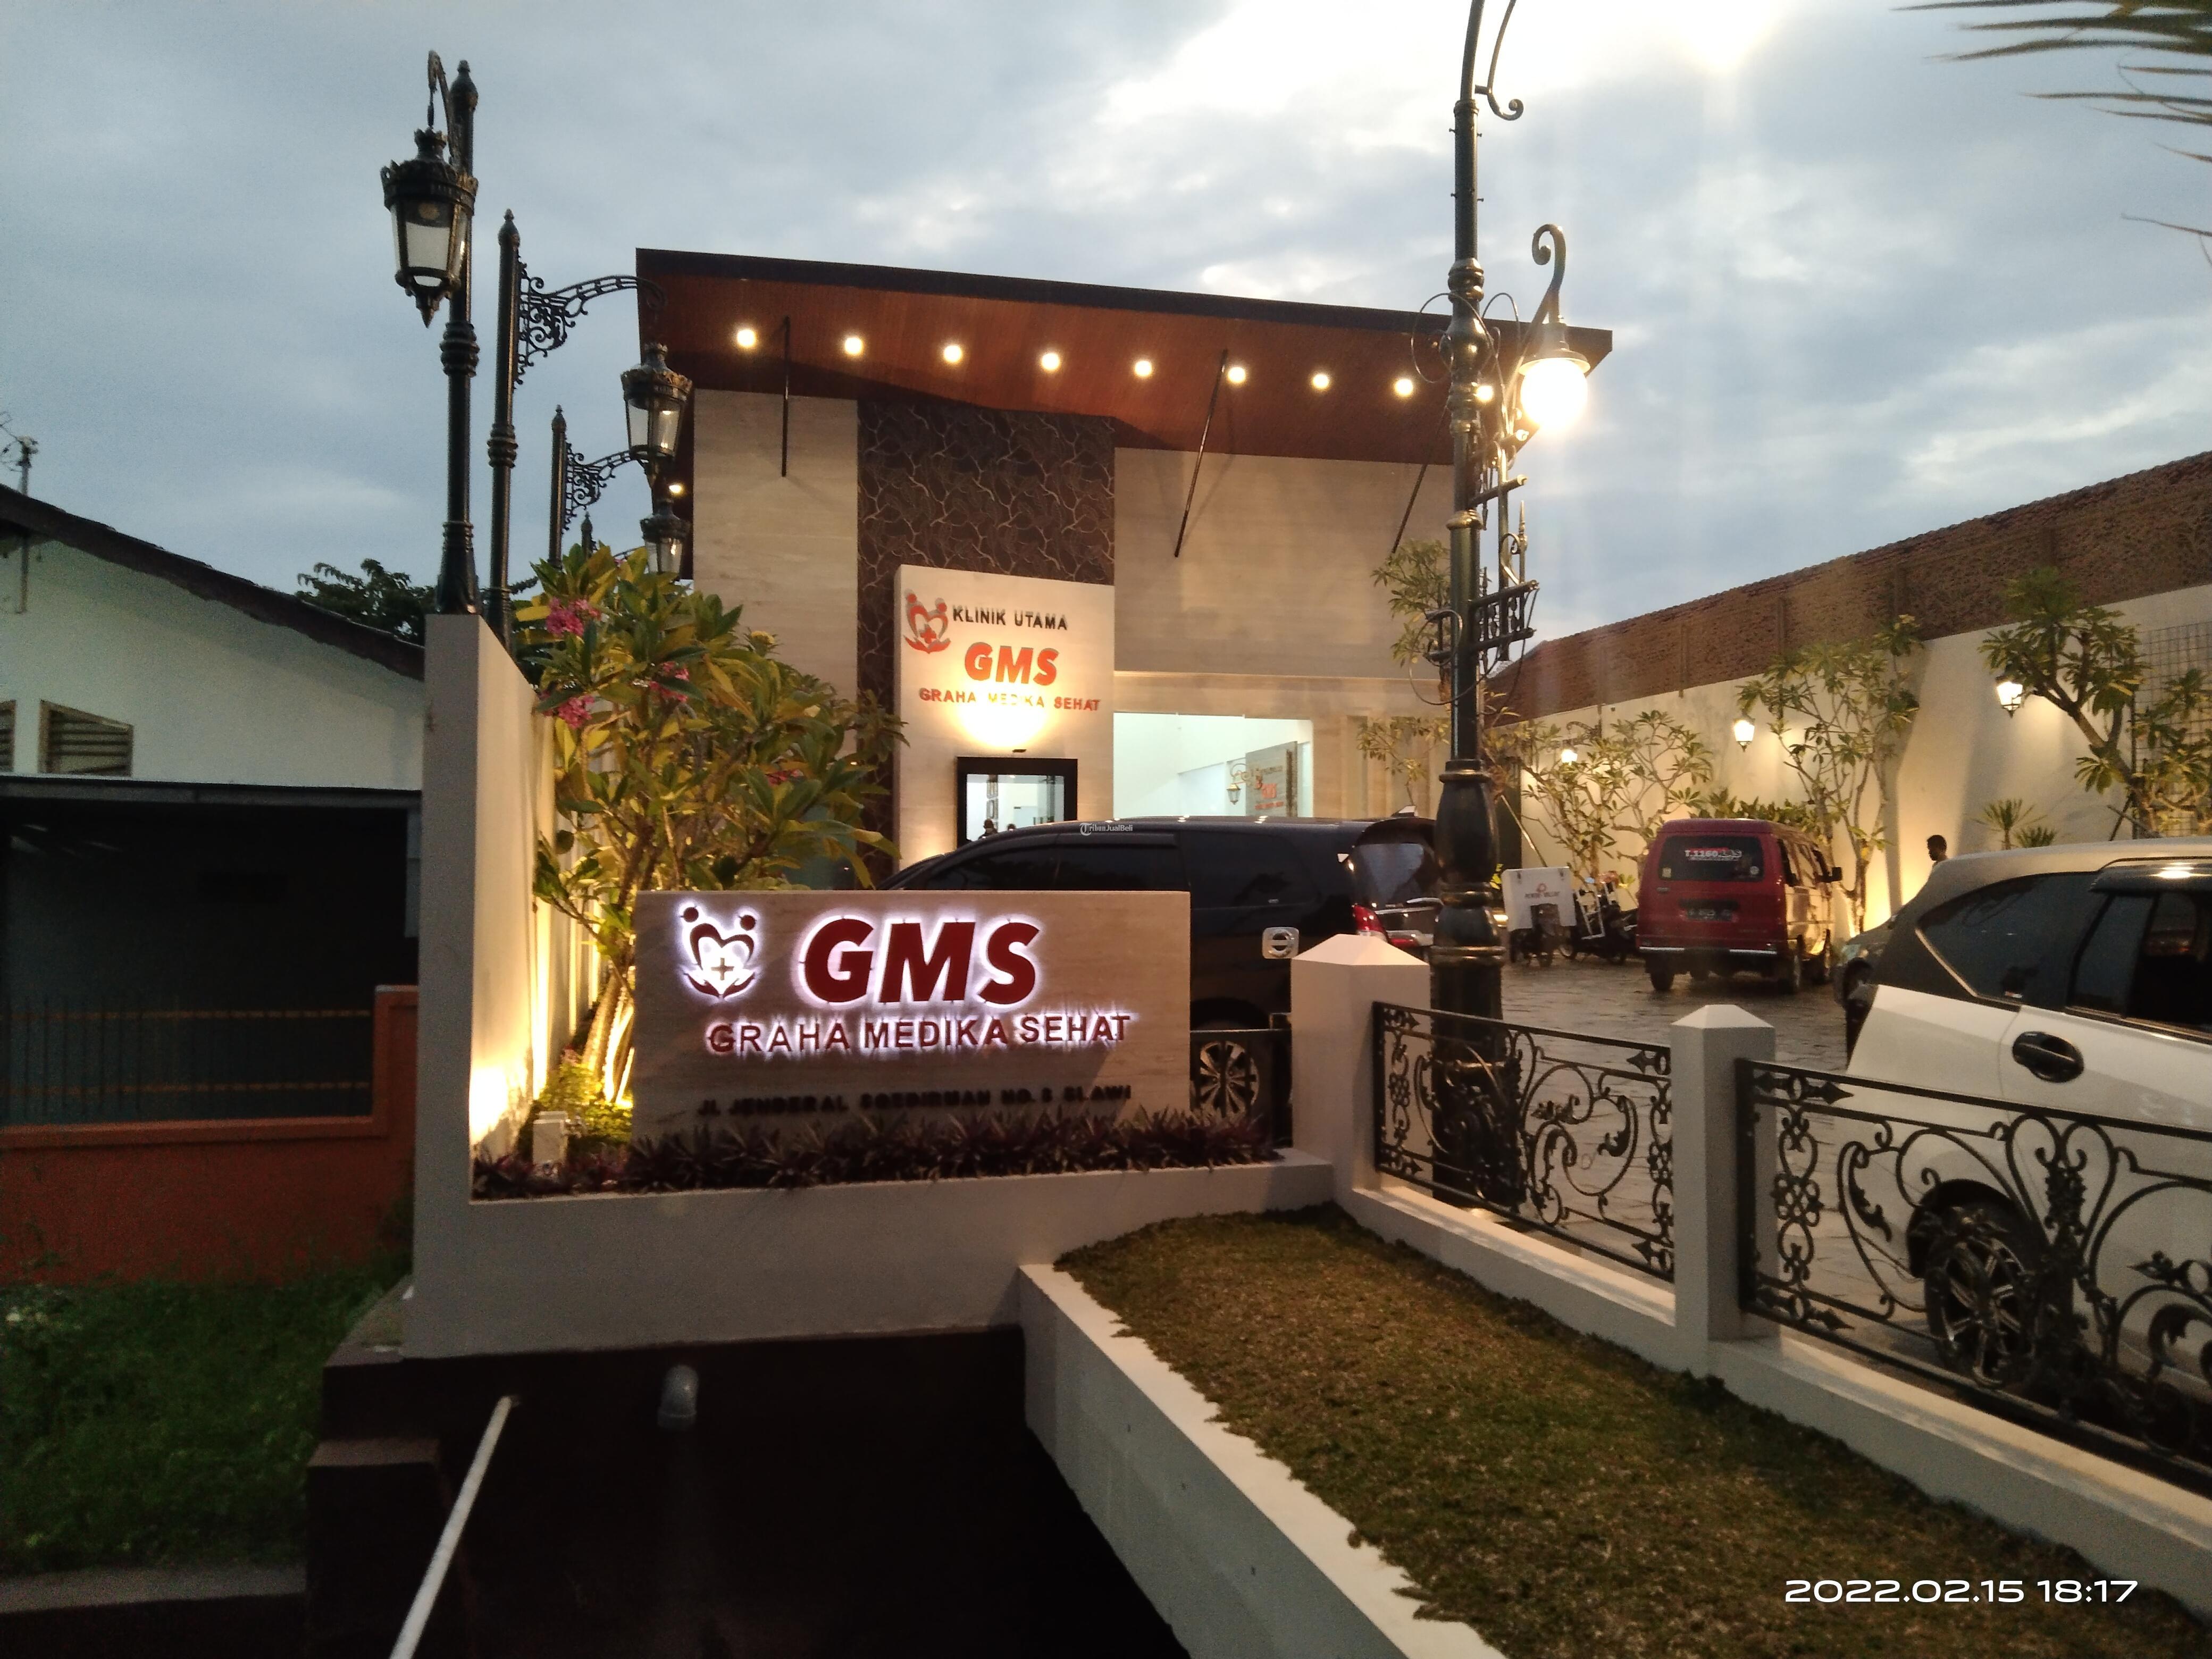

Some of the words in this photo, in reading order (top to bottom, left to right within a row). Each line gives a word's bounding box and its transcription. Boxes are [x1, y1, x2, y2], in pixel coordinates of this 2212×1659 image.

[952, 606, 1007, 626] KLINIK
[1014, 610, 1068, 631] UTAMA
[965, 641, 1059, 686] GMS
[919, 688, 976, 703] GRAHA
[988, 693, 1045, 708] MEDKA
[1054, 696, 1101, 711] SEHAT
[803, 916, 1041, 1006] GMS
[709, 1021, 851, 1053] GRAHA
[864, 1018, 1009, 1049] MEDIKA
[1020, 1014, 1131, 1043] SEHAT
[729, 1095, 849, 1115] JENDERAL
